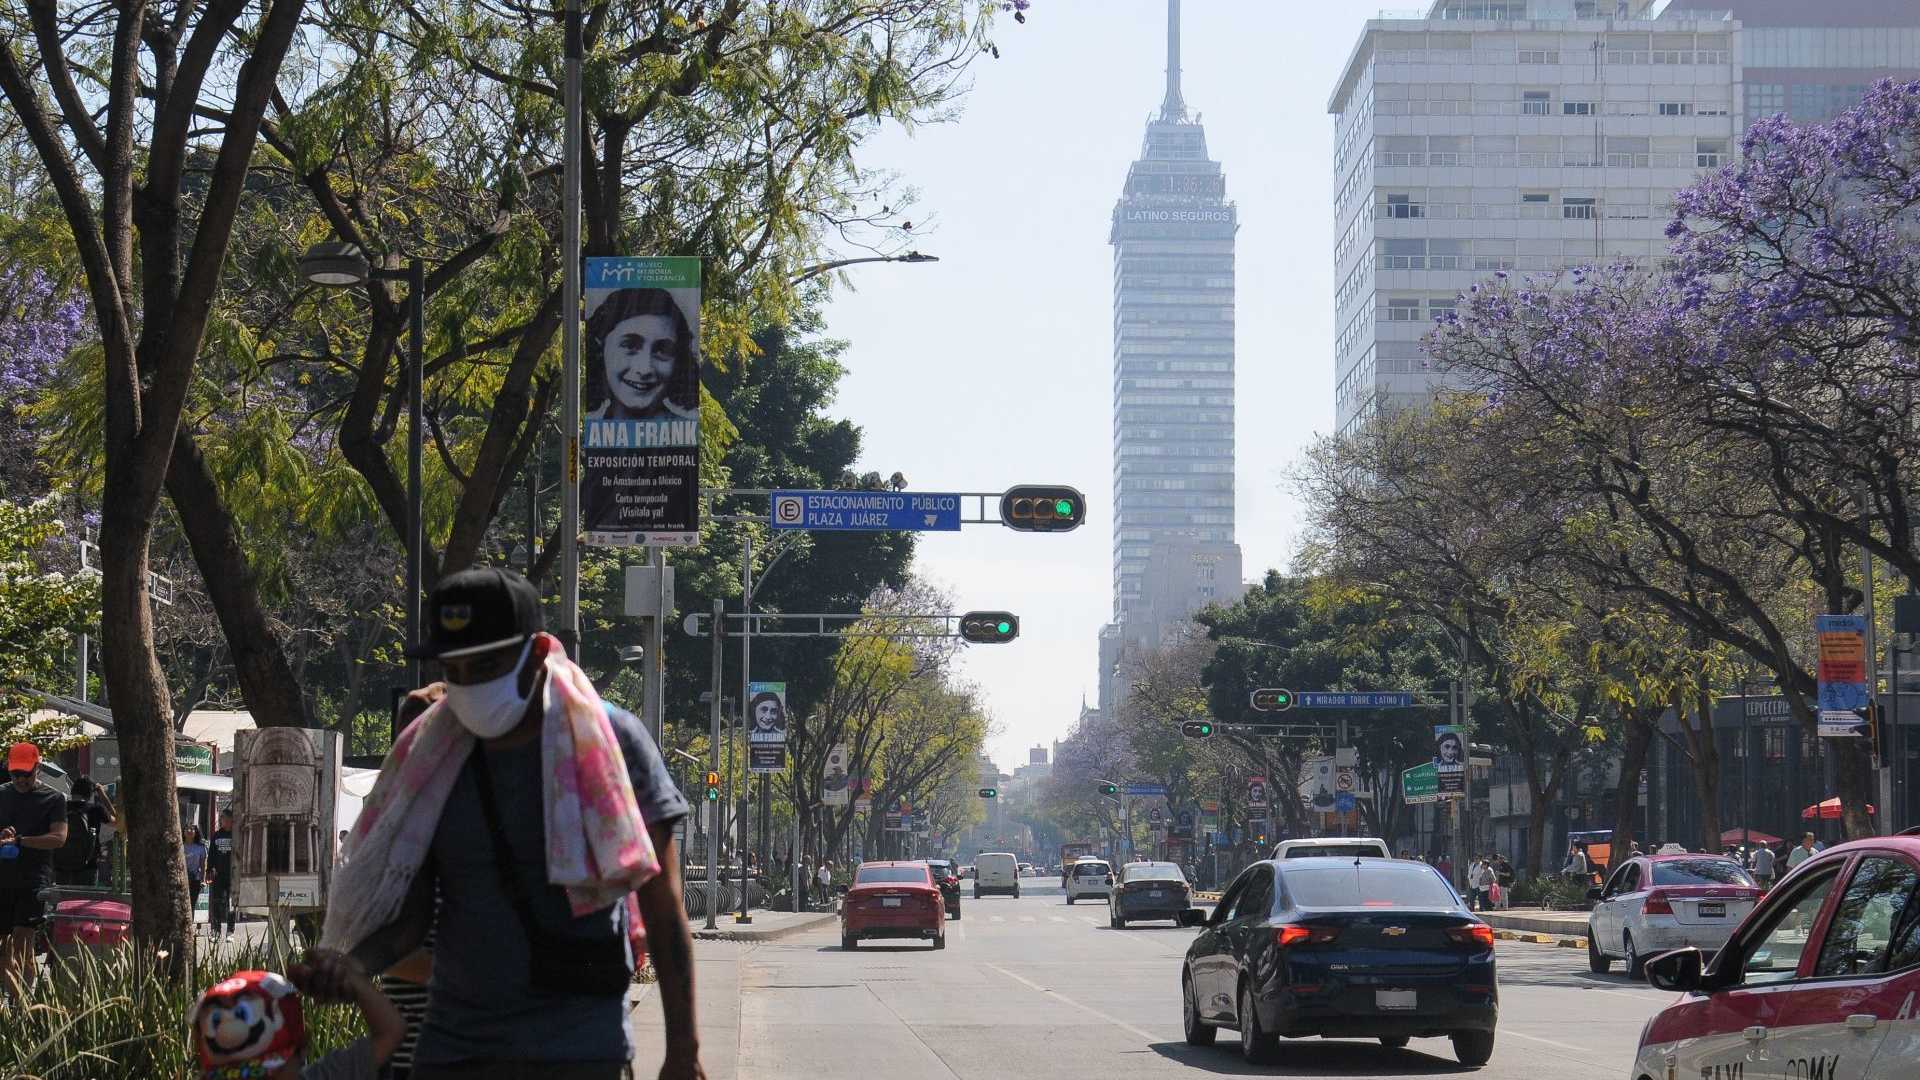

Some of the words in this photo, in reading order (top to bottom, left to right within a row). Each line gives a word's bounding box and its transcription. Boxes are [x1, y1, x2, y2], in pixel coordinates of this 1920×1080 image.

[1127, 210, 1169, 221] LATINO
[1171, 210, 1230, 221] SEGUROS
[588, 421, 629, 447] ANA
[635, 421, 698, 447] FRANK
[588, 453, 645, 468] EXPOSICIÓN
[647, 454, 697, 467] TEMPORAL
[602, 476, 611, 486] De
[652, 478, 657, 486] a
[634, 493, 668, 505] temporada
[808, 495, 904, 511] ESTACIONAMIENTO
[911, 494, 955, 511] PÚBLICO
[652, 506, 664, 519] ya!
[784, 503, 795, 517] E
[808, 512, 843, 526] PLAZA
[850, 511, 888, 527] JUÁREZ
[1316, 695, 1346, 705] MIRADOR
[1350, 695, 1370, 705] TORRE
[1374, 695, 1397, 705] LATINO
